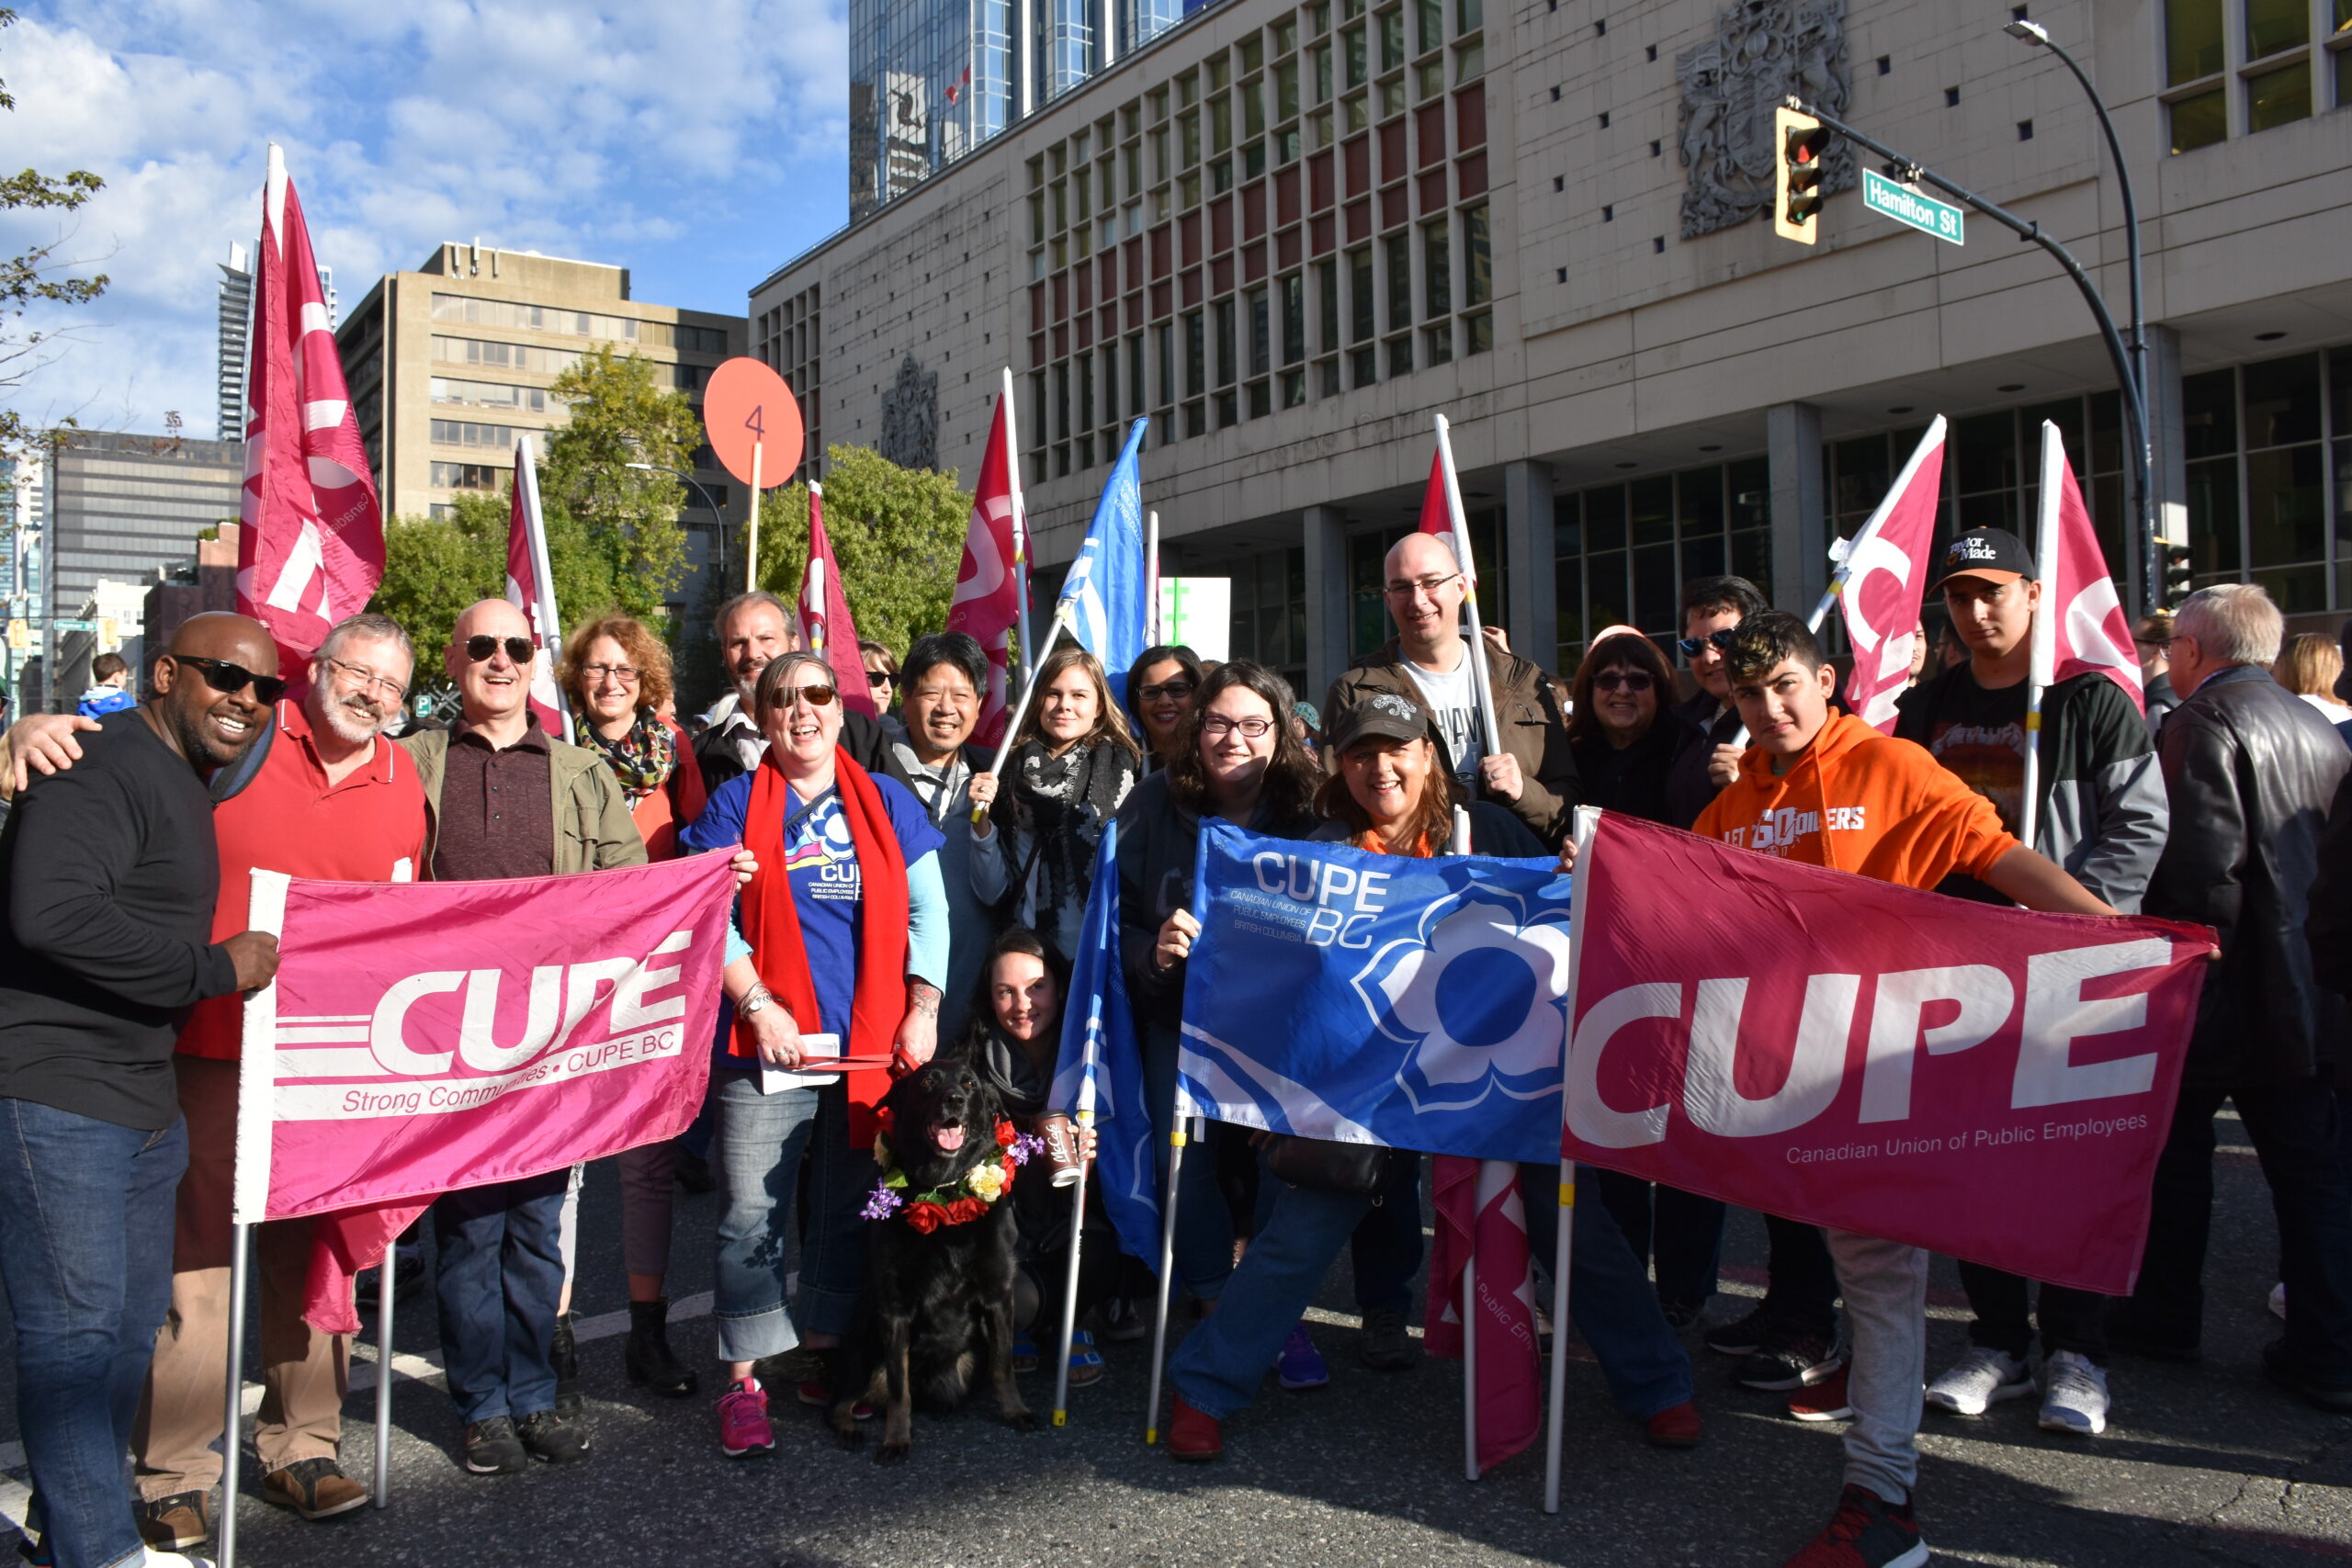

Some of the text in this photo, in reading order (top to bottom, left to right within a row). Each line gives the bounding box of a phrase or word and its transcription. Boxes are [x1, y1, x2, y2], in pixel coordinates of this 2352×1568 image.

[1870, 178, 1957, 236] Hamilton St
[745, 404, 765, 441] 4
[1960, 545, 1996, 560] Made
[1751, 807, 1798, 849] GO
[820, 863, 861, 882] CU
[1252, 851, 1392, 913] CUPE
[1230, 890, 1313, 916] CANADIAN UNION OF
[1233, 905, 1307, 929] PUBLIC EMPLOYEES
[1234, 919, 1302, 943] BRITISH COLUMBIA
[1305, 907, 1378, 949] BC
[370, 930, 693, 1075] CUPE
[1565, 936, 2172, 1148] CUPE
[342, 1090, 422, 1113] Strong
[567, 1039, 634, 1073] CUPE
[642, 1031, 674, 1055] BC
[1046, 1122, 1071, 1163] McCafé
[1786, 1112, 2148, 1165] Canadian Union of Public Employees
[1478, 1282, 1511, 1325] Public
